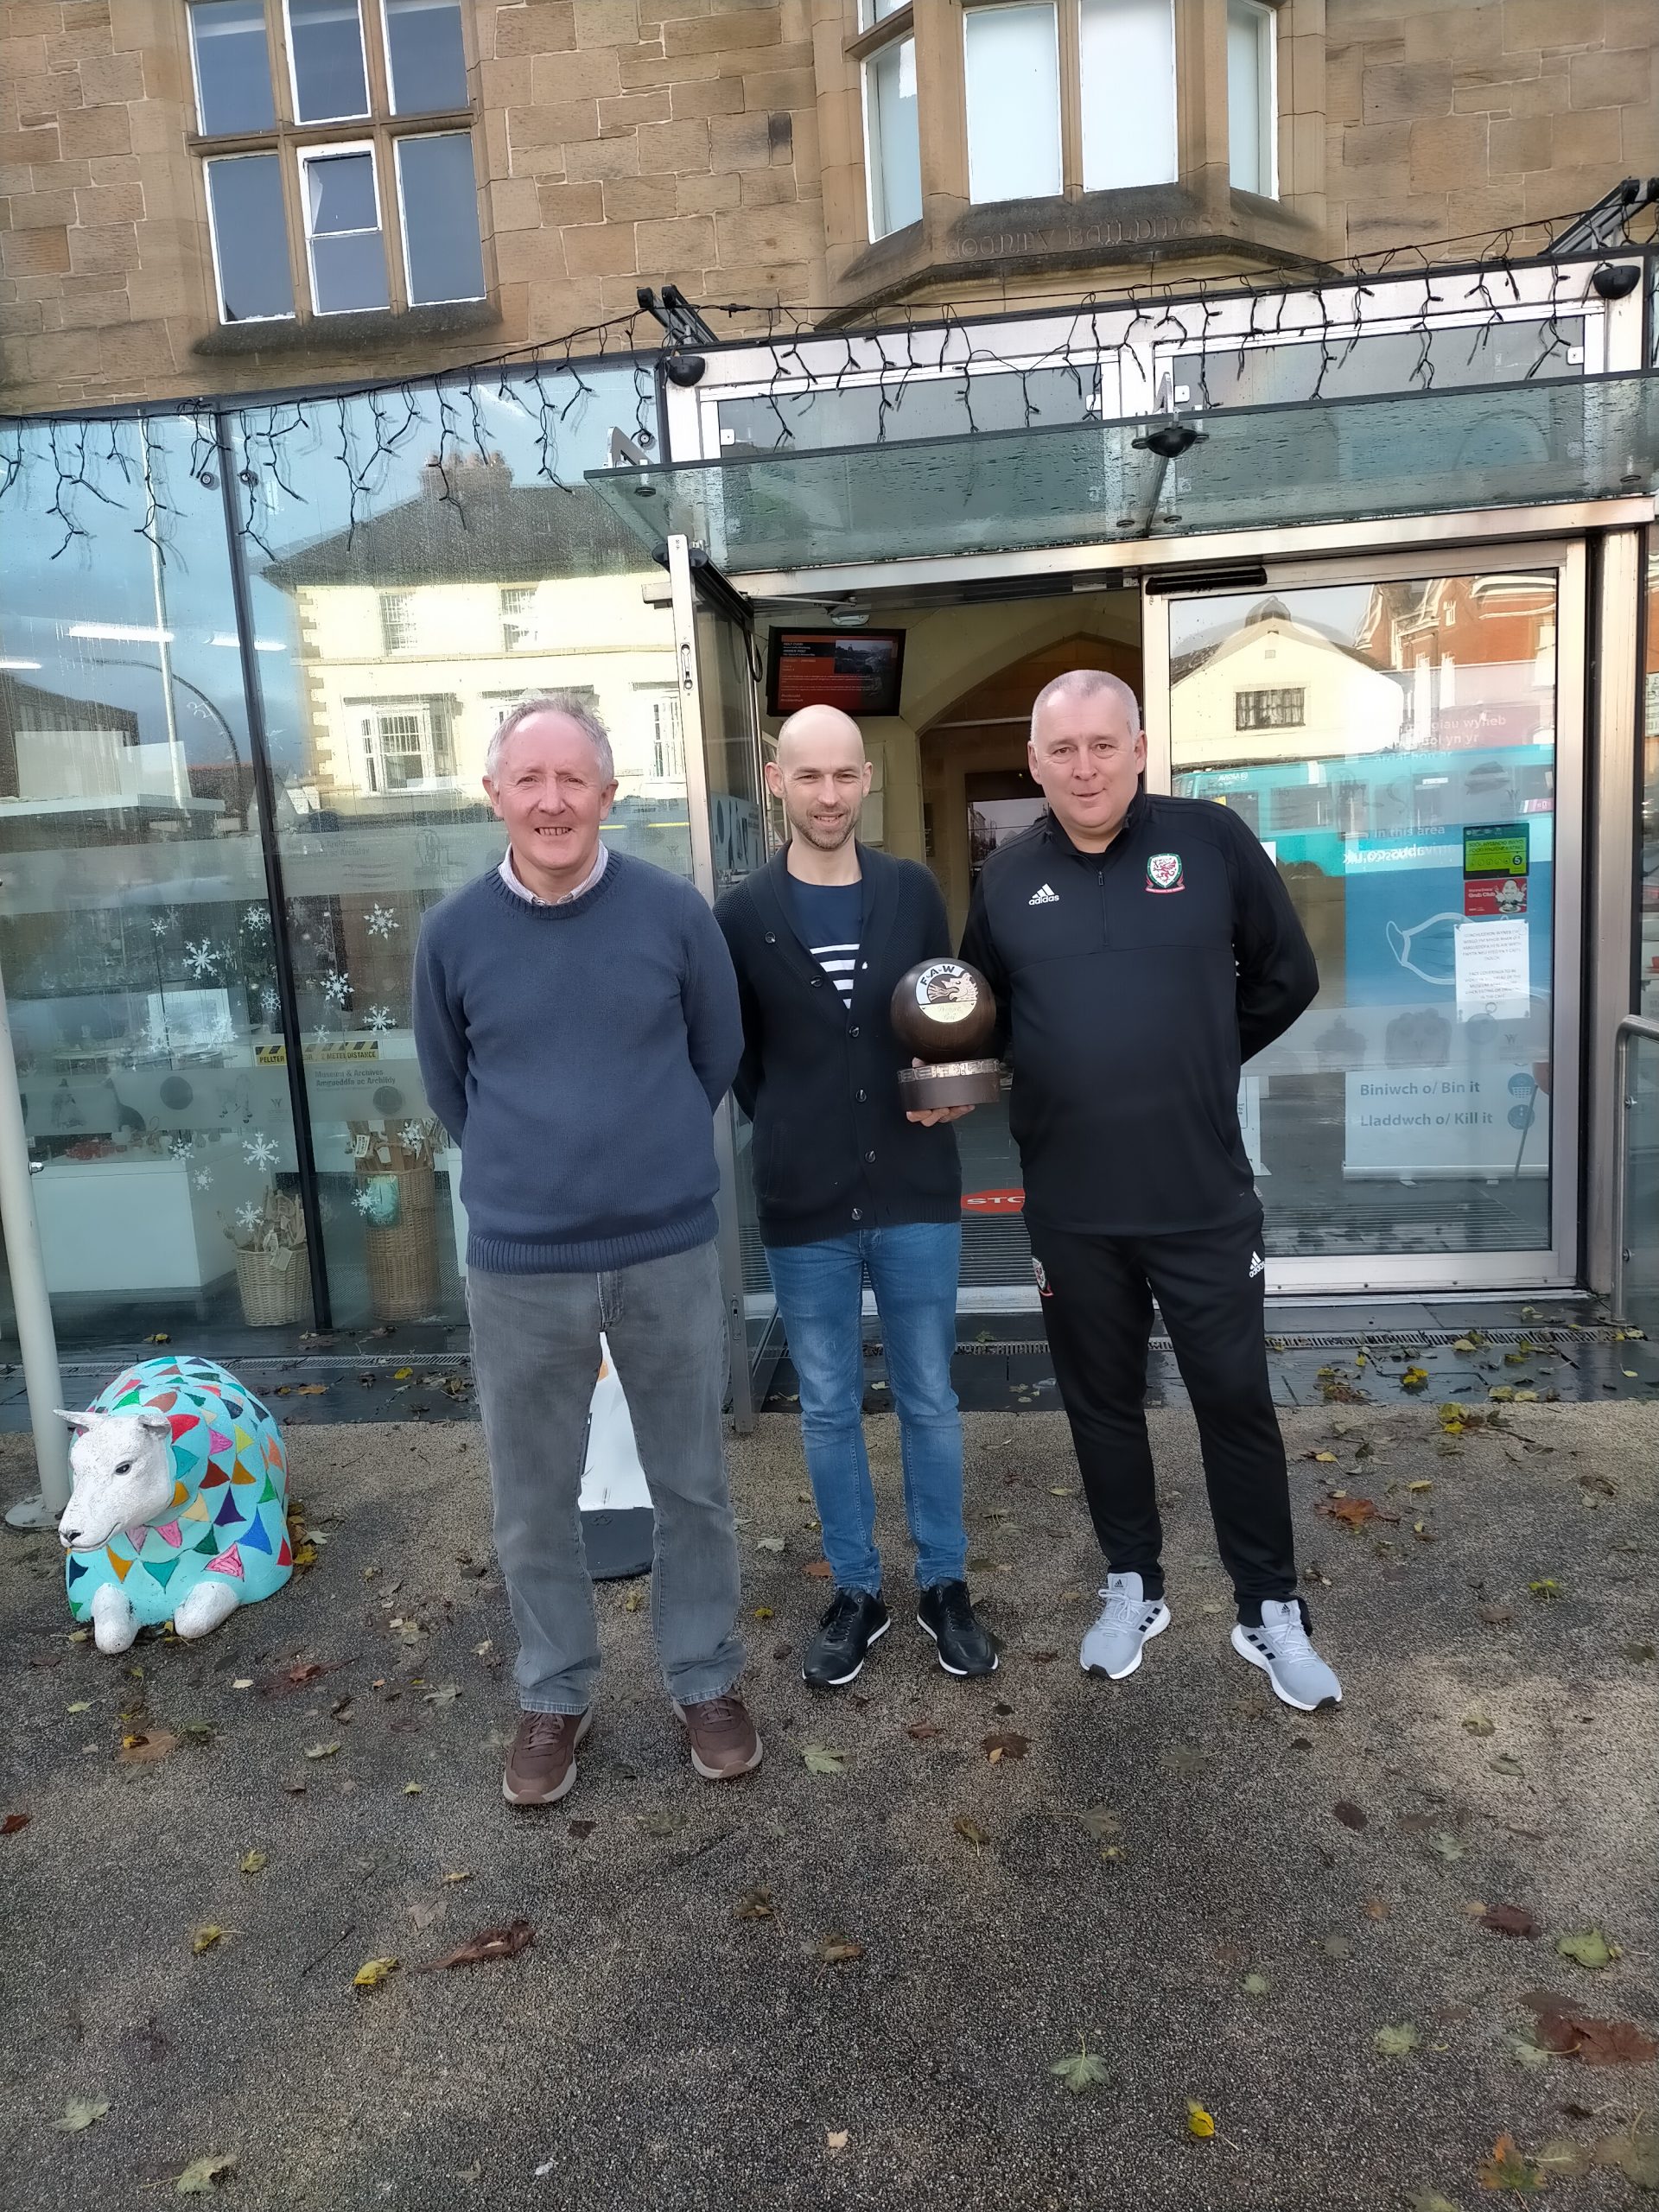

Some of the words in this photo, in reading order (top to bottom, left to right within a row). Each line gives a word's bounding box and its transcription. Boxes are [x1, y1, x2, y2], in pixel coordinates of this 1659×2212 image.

[1418, 825, 1446, 836] area
[1028, 894, 1060, 906] adidas
[1360, 1082, 1418, 1096] Biniwch
[1441, 1081, 1465, 1095] Bin
[1469, 1081, 1480, 1094] it
[1360, 1113, 1432, 1128] Lladdwch
[1454, 1111, 1478, 1126] Kill
[1482, 1111, 1493, 1125] it
